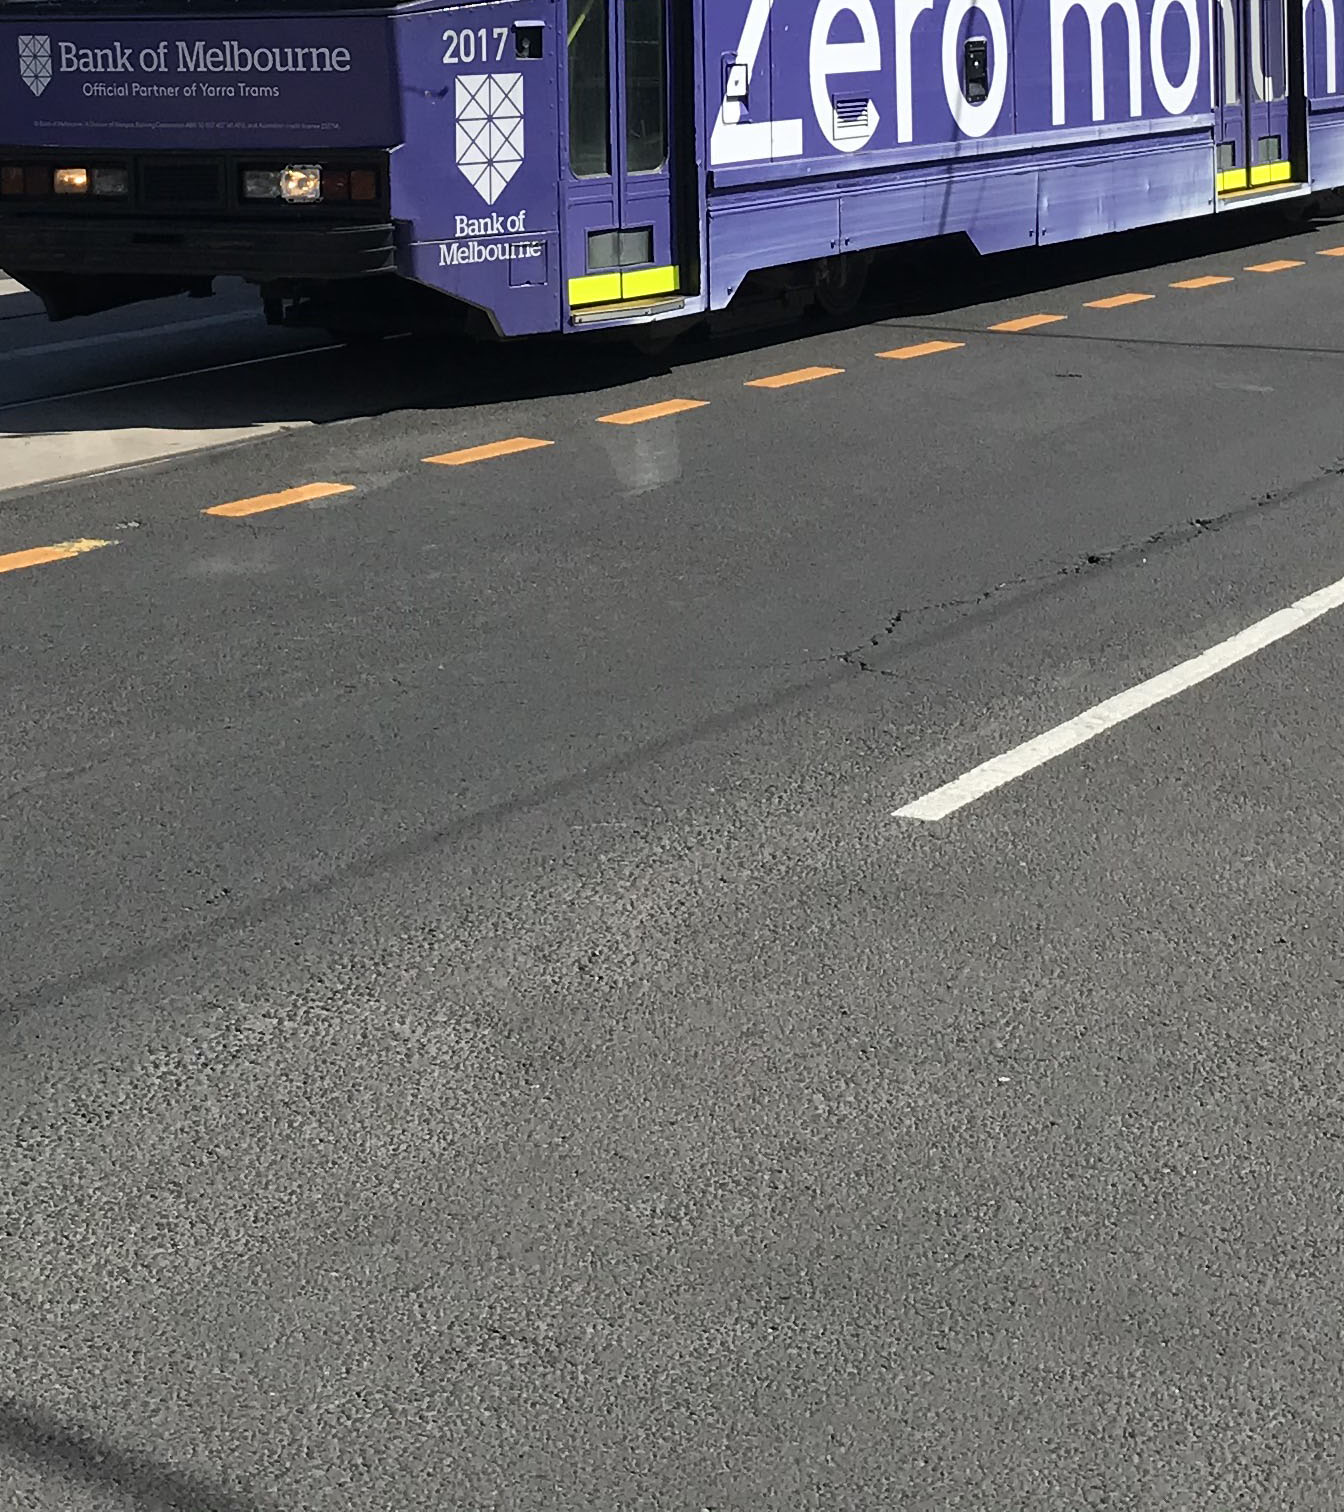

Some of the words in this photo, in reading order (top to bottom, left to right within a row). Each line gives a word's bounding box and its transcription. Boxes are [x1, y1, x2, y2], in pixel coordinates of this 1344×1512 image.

[57, 41, 135, 72] Bank
[139, 40, 169, 72] of
[176, 41, 352, 72] Melbourne
[441, 27, 509, 65] 2017
[82, 82, 129, 97] Official
[132, 83, 179, 97] Partner
[183, 82, 197, 97] of
[199, 83, 235, 97] Yarra
[238, 83, 280, 97] Trams
[455, 212, 504, 237] Bank
[506, 210, 526, 232] of
[438, 240, 542, 266] Melbourne
